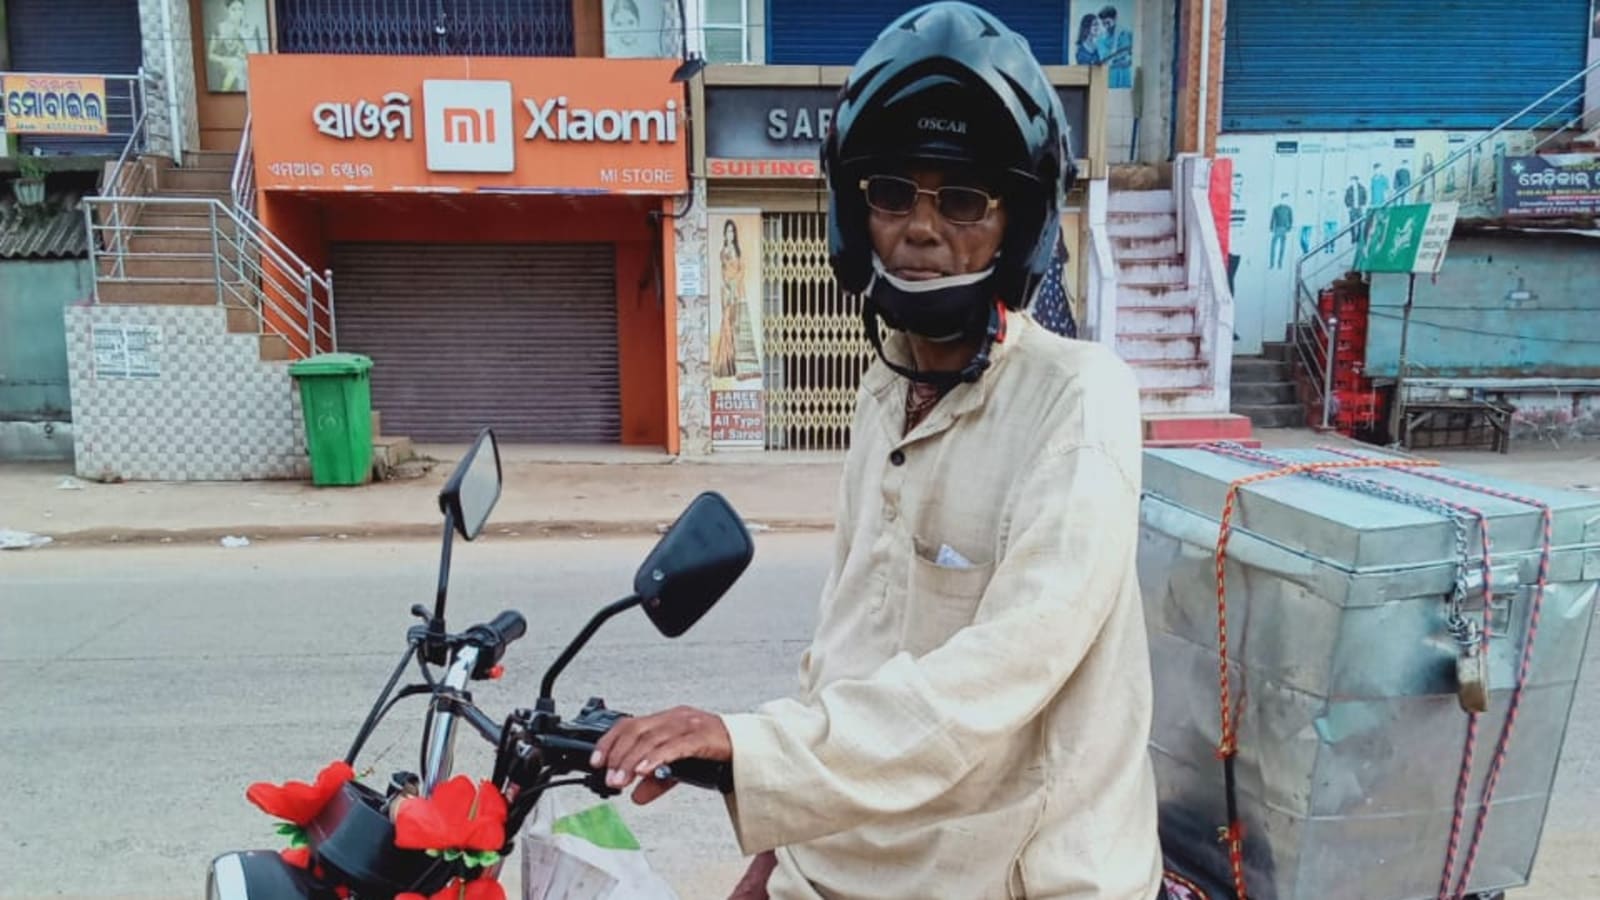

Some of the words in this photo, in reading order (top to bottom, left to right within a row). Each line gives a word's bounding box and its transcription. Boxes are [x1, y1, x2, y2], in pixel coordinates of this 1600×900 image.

[523, 96, 677, 142] Xiaomi
[917, 118, 967, 134] OSCAR
[600, 169, 618, 183] MI
[623, 168, 674, 184] STORE
[711, 161, 816, 176] SUITING
